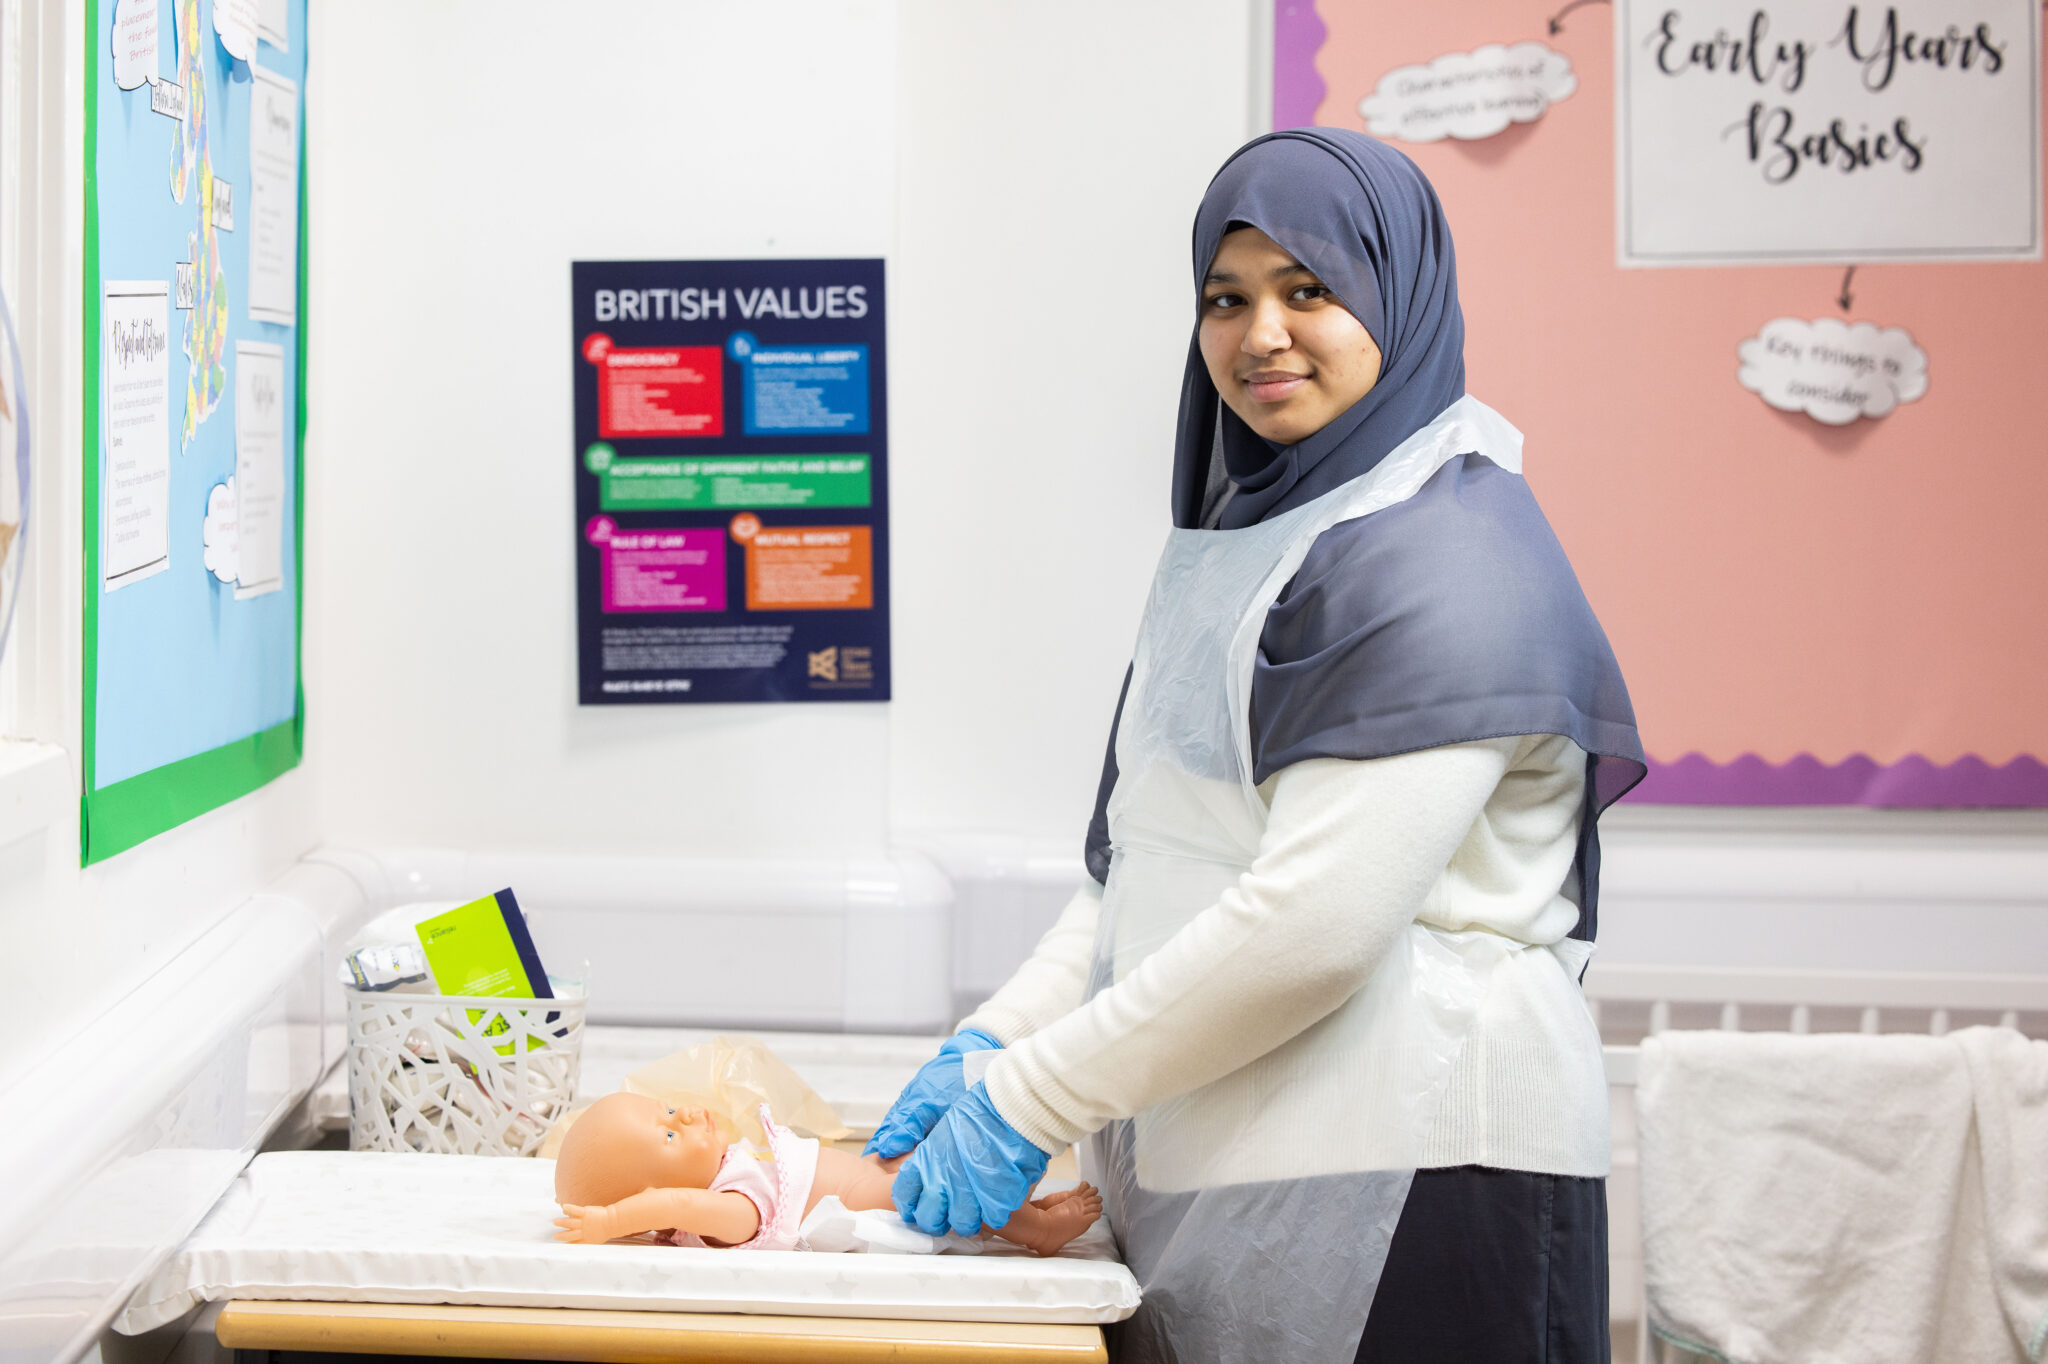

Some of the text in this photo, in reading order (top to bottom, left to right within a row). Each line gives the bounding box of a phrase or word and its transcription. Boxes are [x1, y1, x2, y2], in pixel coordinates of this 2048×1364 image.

[1645, 4, 2006, 92] Early Years
[1528, 57, 1547, 76] of
[1722, 102, 1926, 184] Basics
[595, 285, 869, 322] BRITISH VALUES
[1765, 334, 1902, 379] Key things to
[1785, 379, 1869, 407] consider
[610, 463, 680, 477] ACCEPTANCE
[682, 462, 699, 475] OF
[700, 461, 760, 475] DIFFERENT
[801, 461, 826, 473] AND
[610, 535, 686, 549] RULE OF LAW
[754, 532, 851, 546] MUTUAL RESPECT
